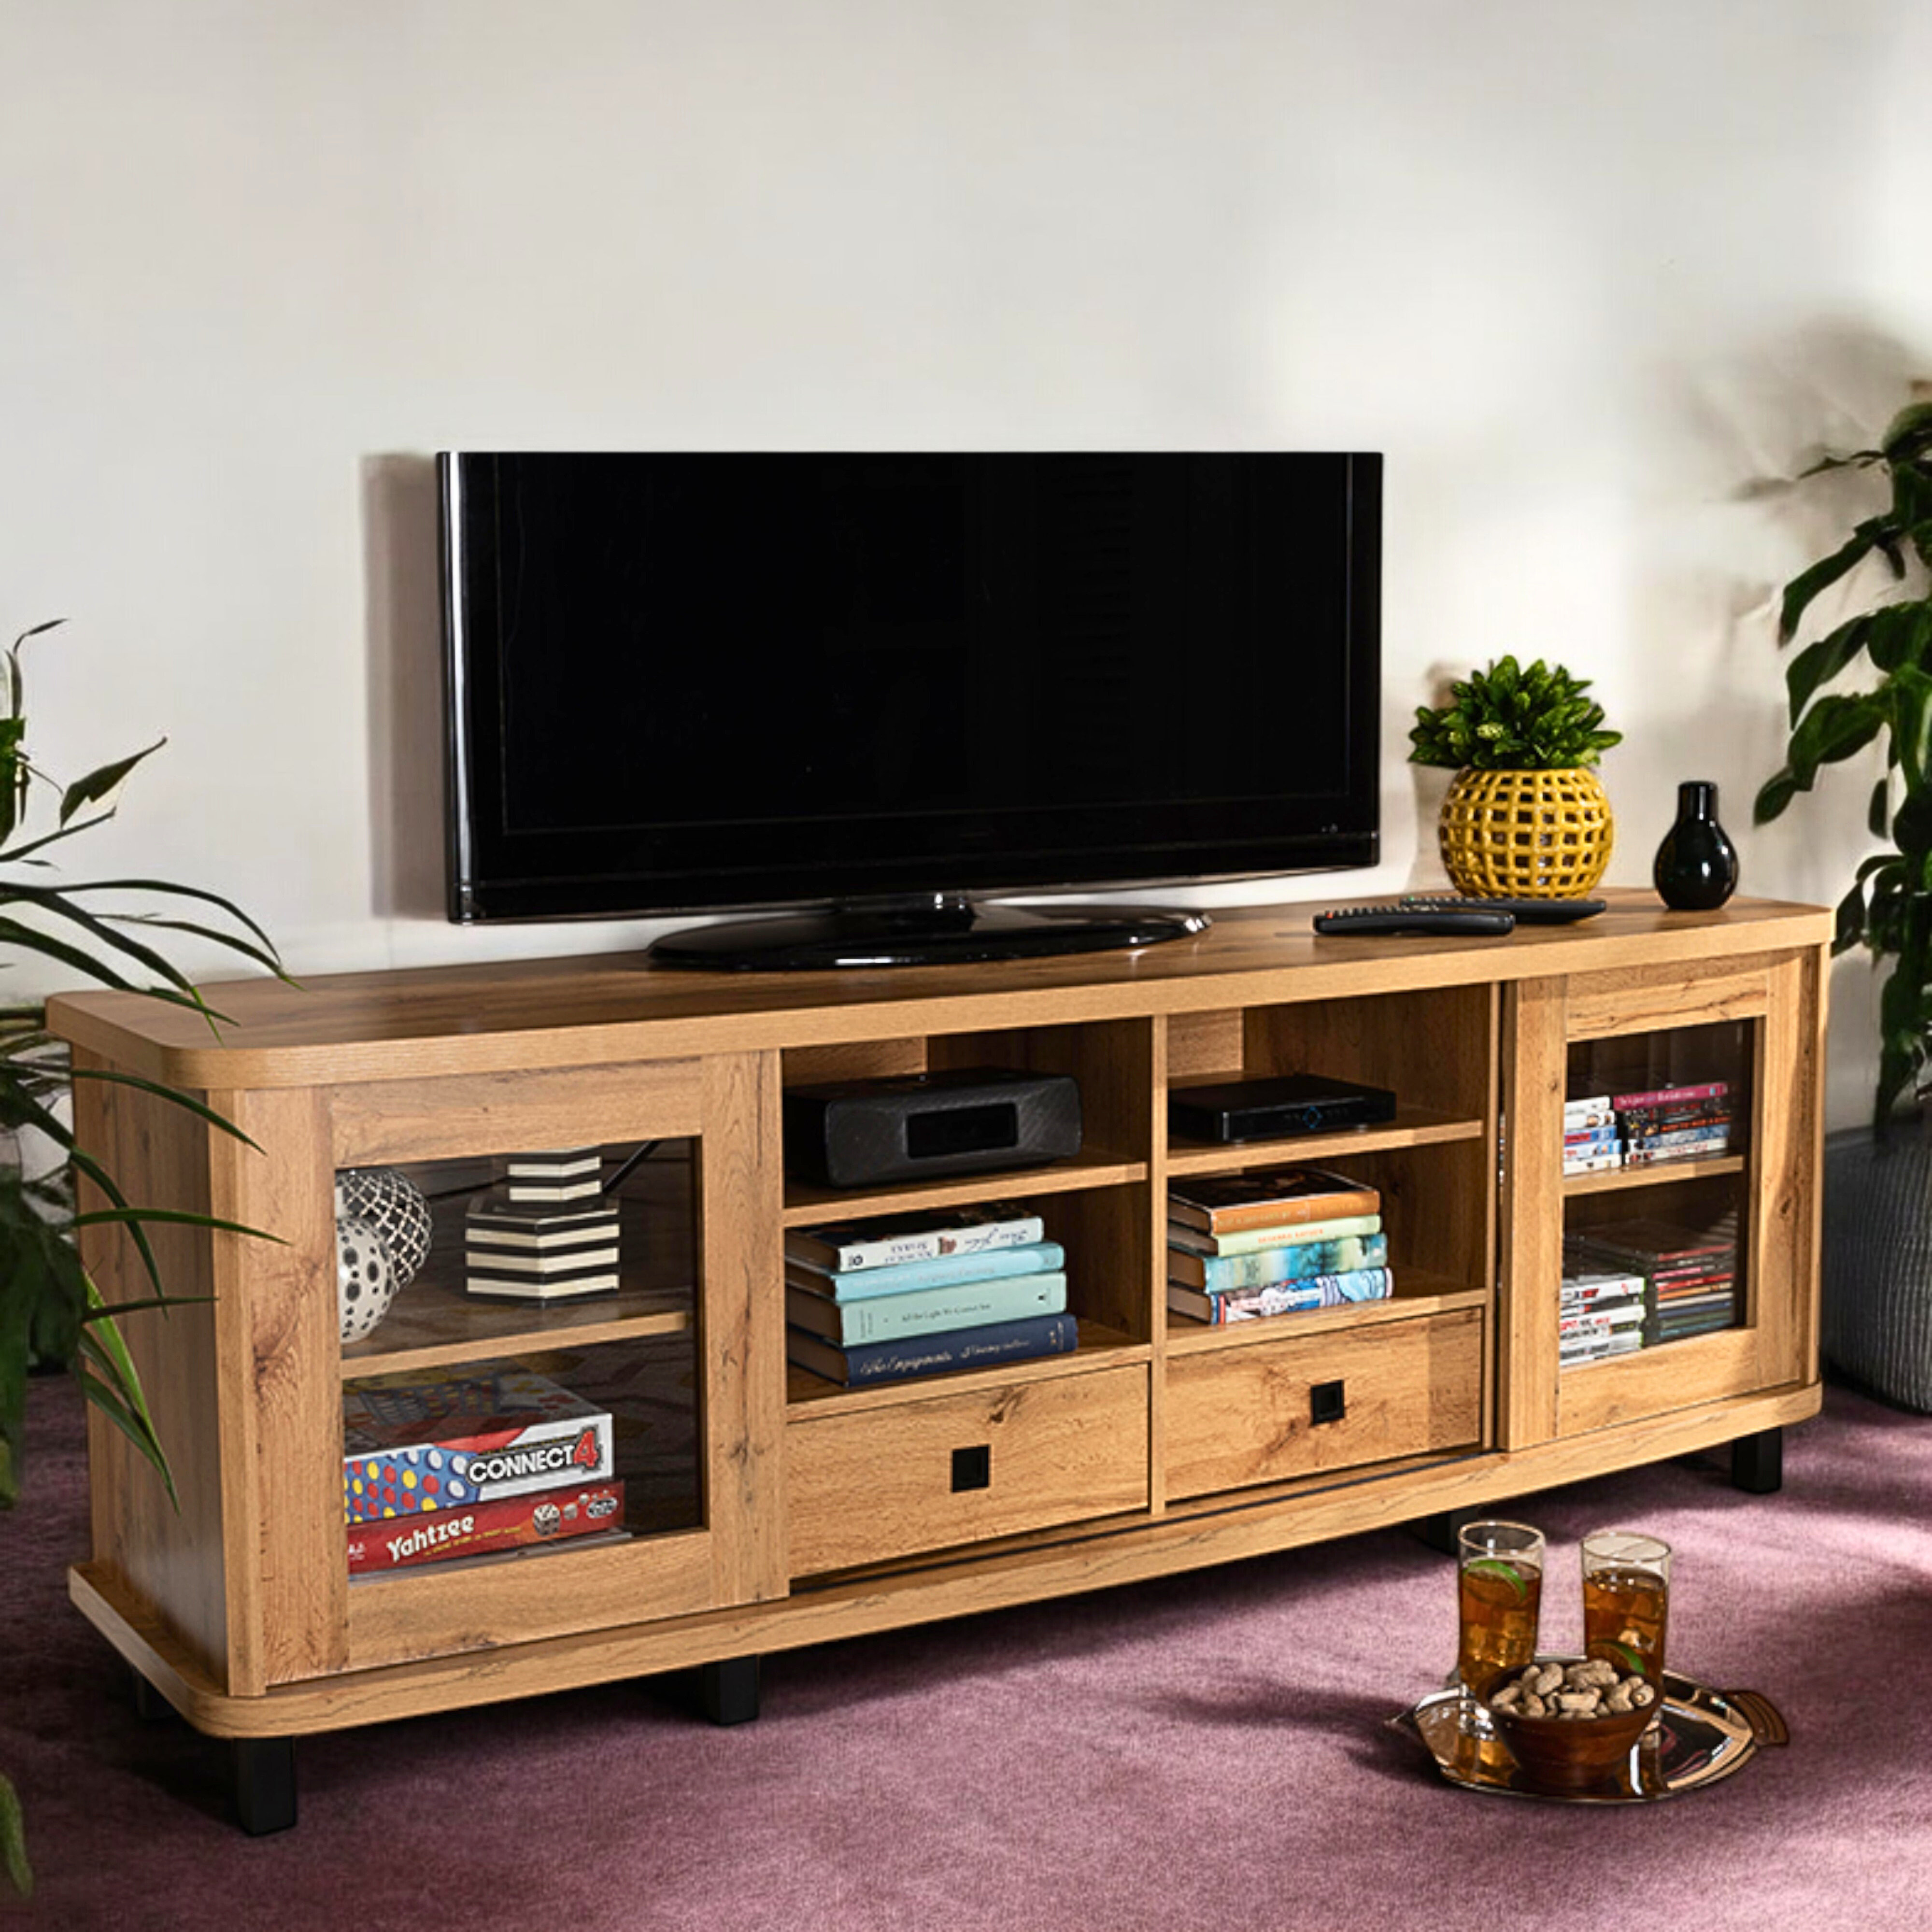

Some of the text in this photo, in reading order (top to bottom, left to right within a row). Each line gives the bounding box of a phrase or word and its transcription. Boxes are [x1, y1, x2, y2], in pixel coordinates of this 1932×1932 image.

[469, 1430, 598, 1482] CONNECT 4
[386, 1515, 474, 1563] Yahtzee
